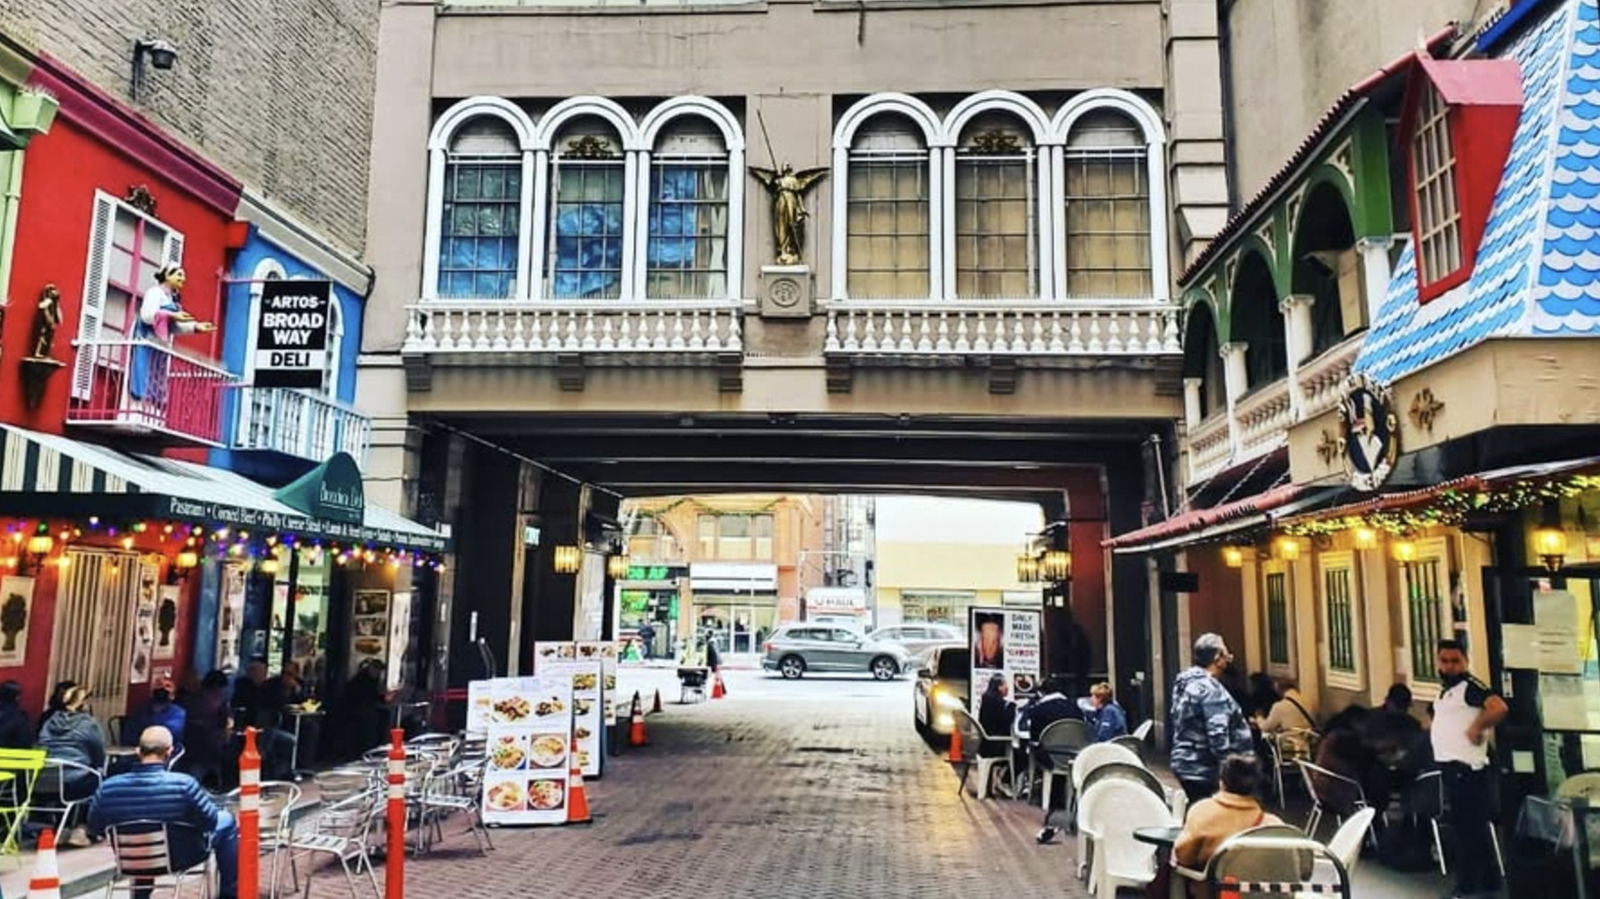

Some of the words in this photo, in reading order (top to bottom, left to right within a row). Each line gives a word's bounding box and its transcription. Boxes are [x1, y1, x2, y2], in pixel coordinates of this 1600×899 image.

[263, 313, 324, 328] BROAD
[273, 329, 312, 345] WAY
[270, 352, 310, 367] DELI
[170, 497, 206, 517] Pastrami
[212, 503, 239, 522] Corned
[241, 506, 258, 525] Beef
[262, 511, 281, 532] Philly
